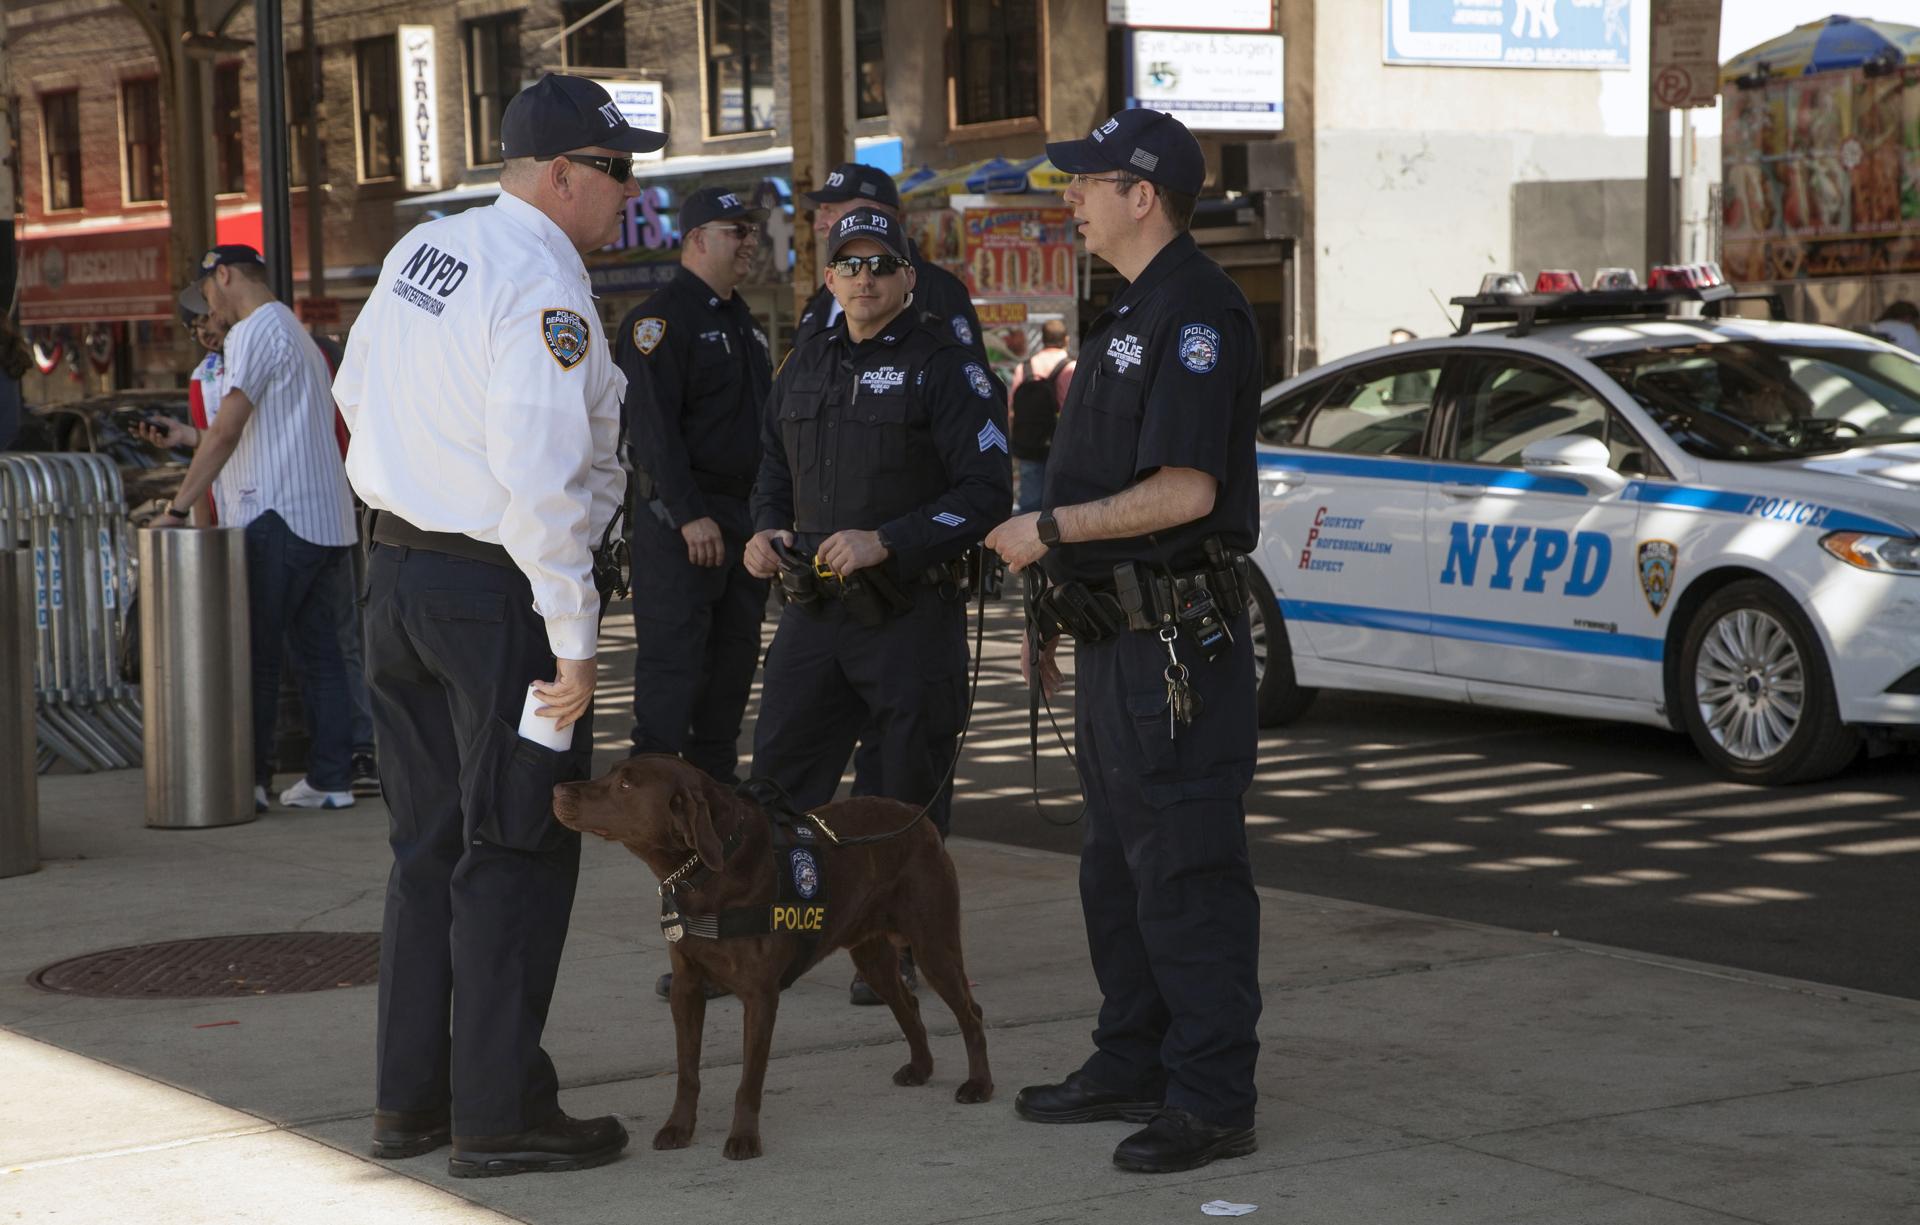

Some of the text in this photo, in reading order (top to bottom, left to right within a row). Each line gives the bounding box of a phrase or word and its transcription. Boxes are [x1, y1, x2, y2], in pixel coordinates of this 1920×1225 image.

[413, 59, 432, 183] TRAVEL
[825, 172, 844, 187] PD
[67, 247, 159, 285] DISCOUNT
[400, 243, 469, 297] NYPD
[392, 279, 446, 317] COUNTERTERRORISM
[1184, 326, 1218, 346] POLICE
[862, 371, 905, 381] POLICE
[1314, 506, 1365, 530] COURTESY
[1746, 496, 1830, 526] POLICE
[1306, 527, 1393, 555] PROFESSIONALISM
[50, 530, 62, 606] NYPD
[1298, 549, 1345, 573] RESPECT
[1440, 522, 1612, 597] NYPD
[36, 550, 48, 625] NYPD
[773, 906, 825, 931] POLCE
